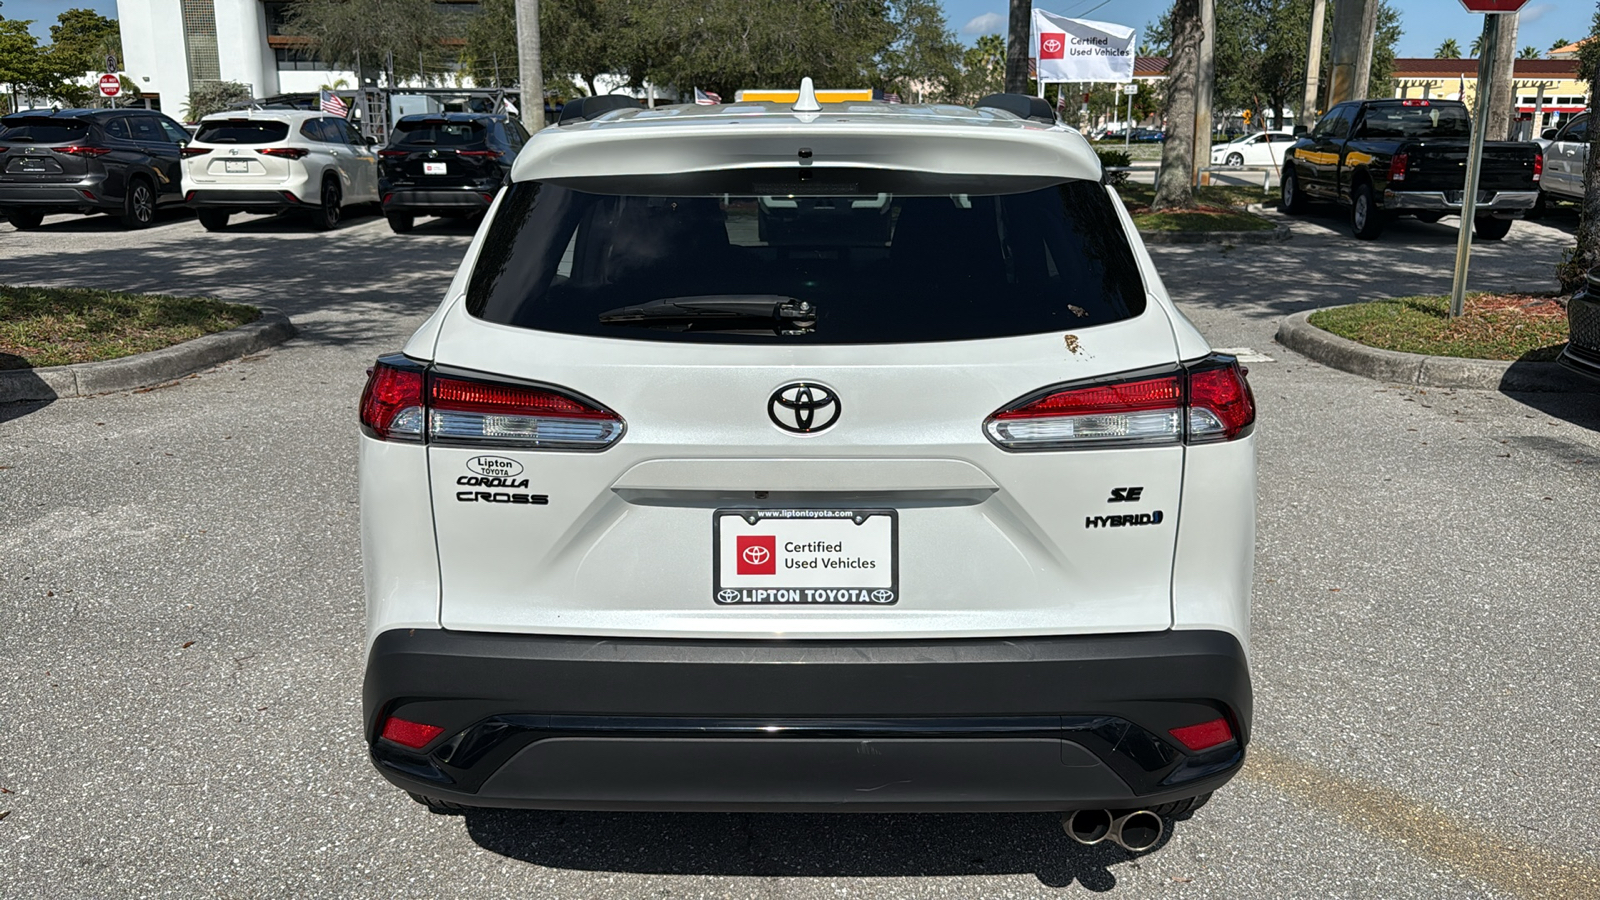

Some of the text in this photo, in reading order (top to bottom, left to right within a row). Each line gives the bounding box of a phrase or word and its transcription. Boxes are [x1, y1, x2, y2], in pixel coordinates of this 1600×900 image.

[1070, 37, 1108, 45] Certified
[1070, 48, 1130, 57] Used Vehicles
[477, 457, 513, 469] Lipton
[481, 468, 509, 476] TOYOTA
[456, 476, 530, 489] COROLLA
[456, 491, 549, 505] CROSS
[1107, 486, 1144, 503] SE
[757, 510, 853, 518] www.liptontoyota.com
[1085, 513, 1152, 529] HYBRID
[784, 541, 842, 553] Certified
[784, 557, 876, 569] Used Vehicles
[742, 589, 870, 603] LIPTON TOYOTA
